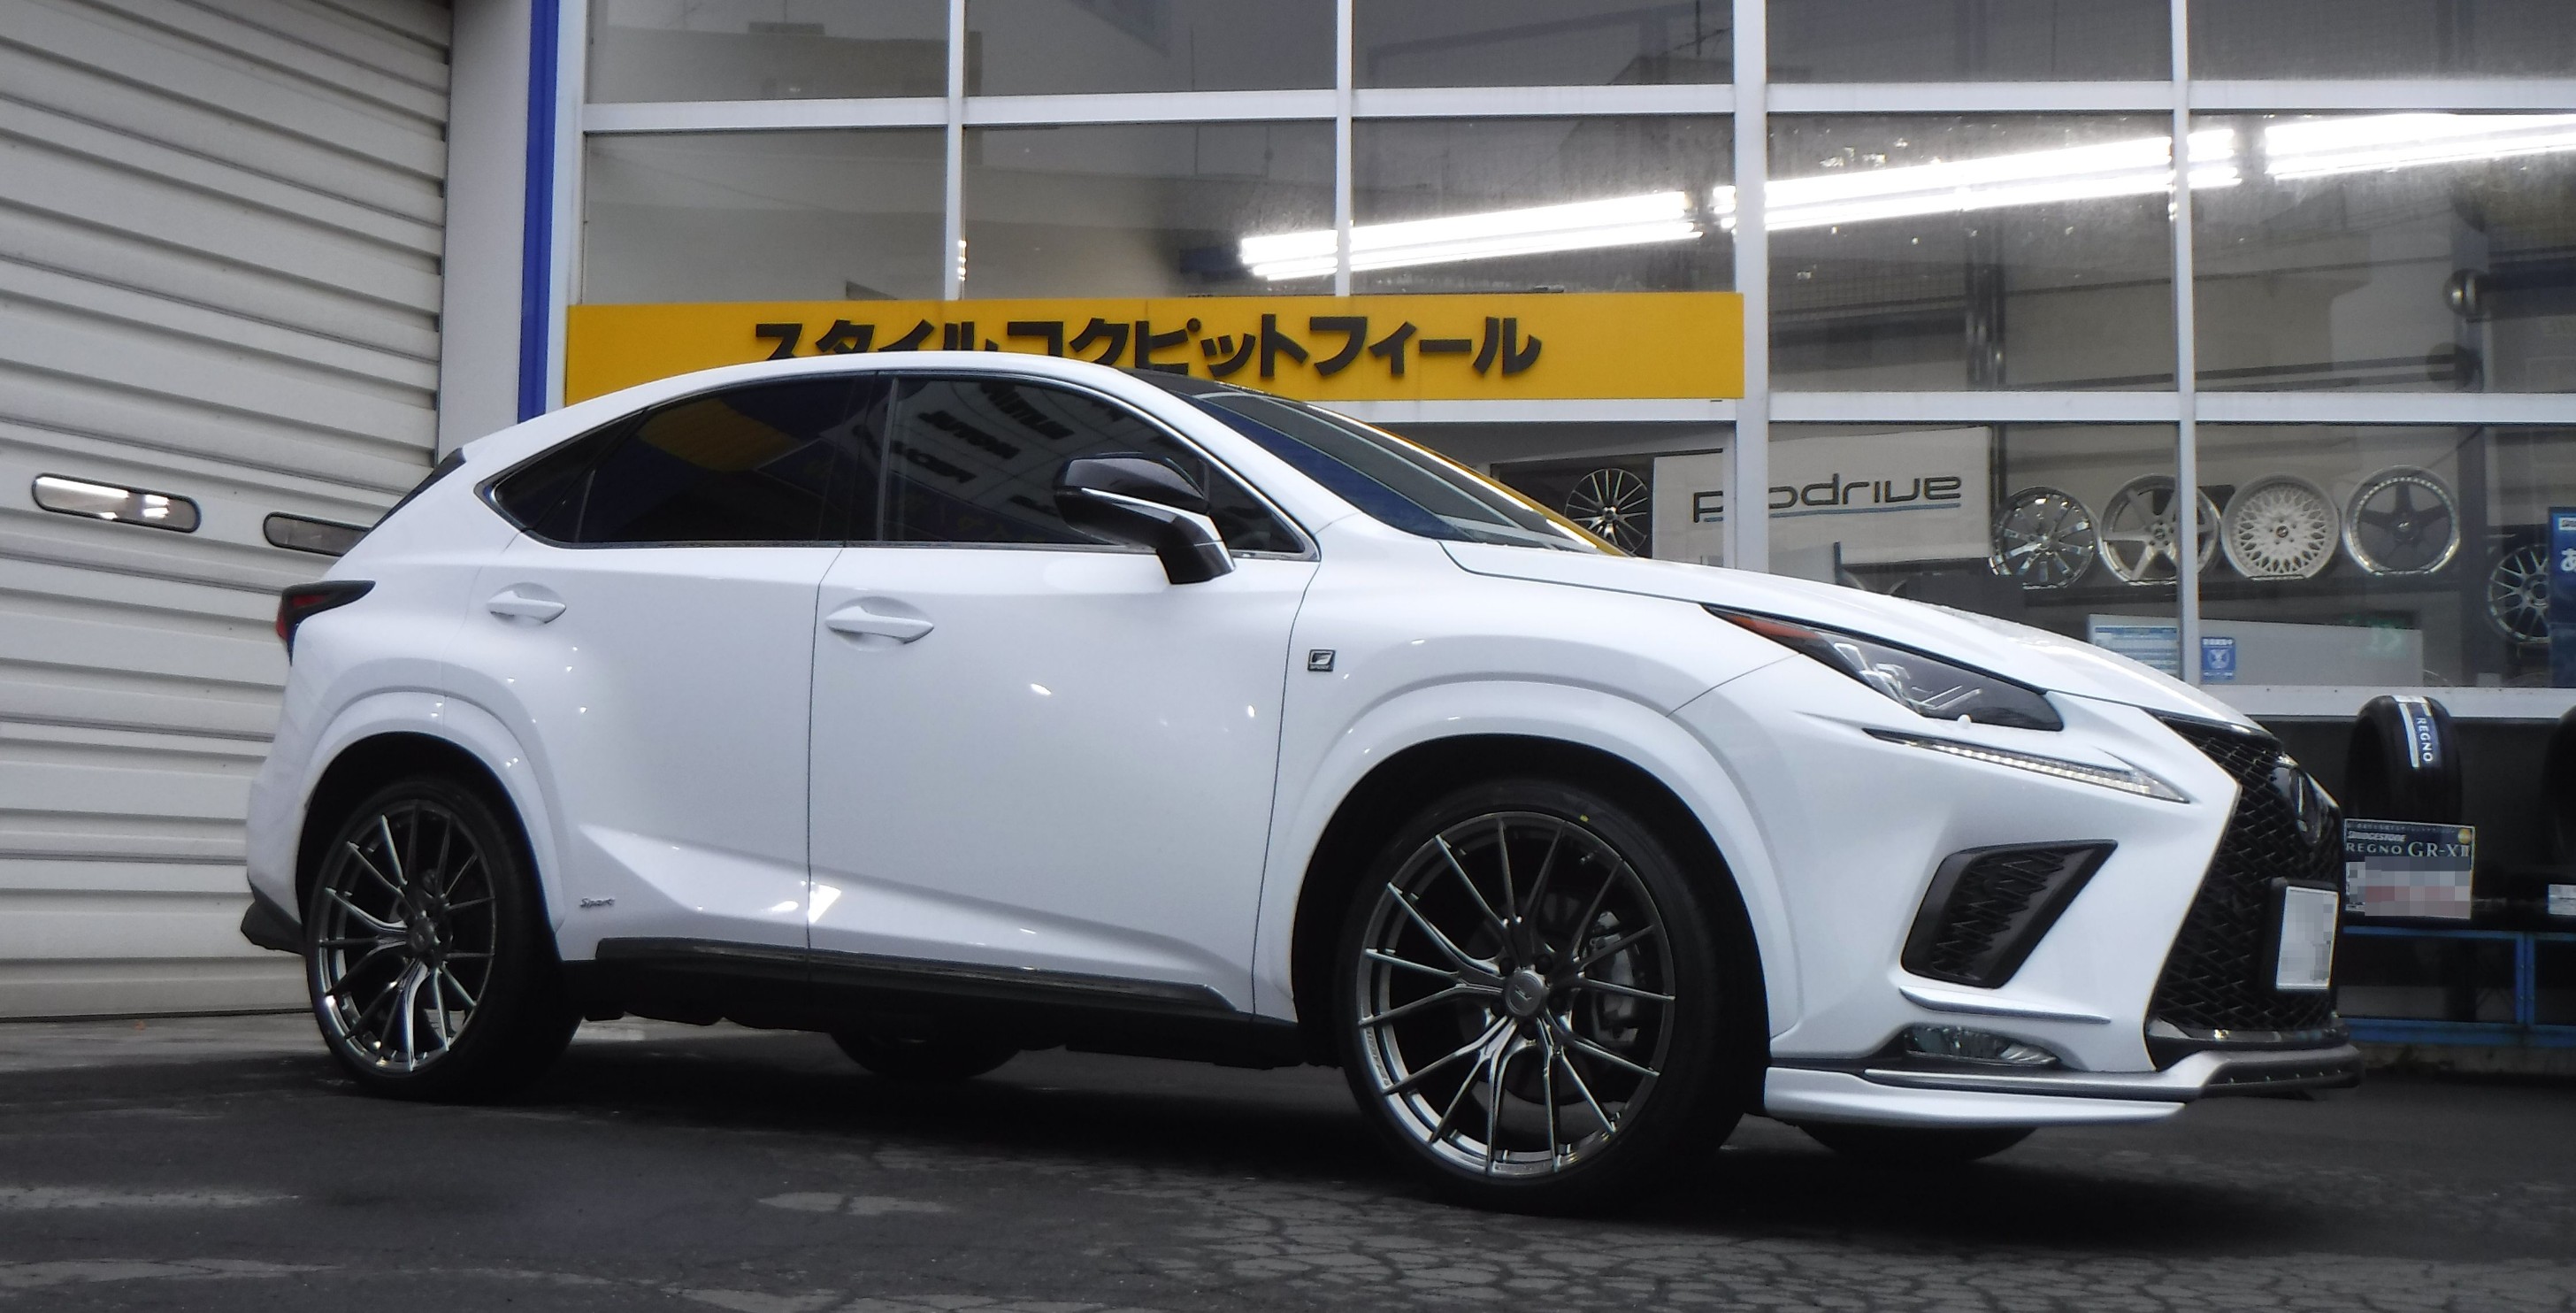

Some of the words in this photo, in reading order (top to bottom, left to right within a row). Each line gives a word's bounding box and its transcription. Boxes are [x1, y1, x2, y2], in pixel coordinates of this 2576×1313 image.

[1693, 472, 1962, 523] podrive
[2416, 717, 2434, 762] REGNO
[2345, 842, 2403, 855] REGNO
